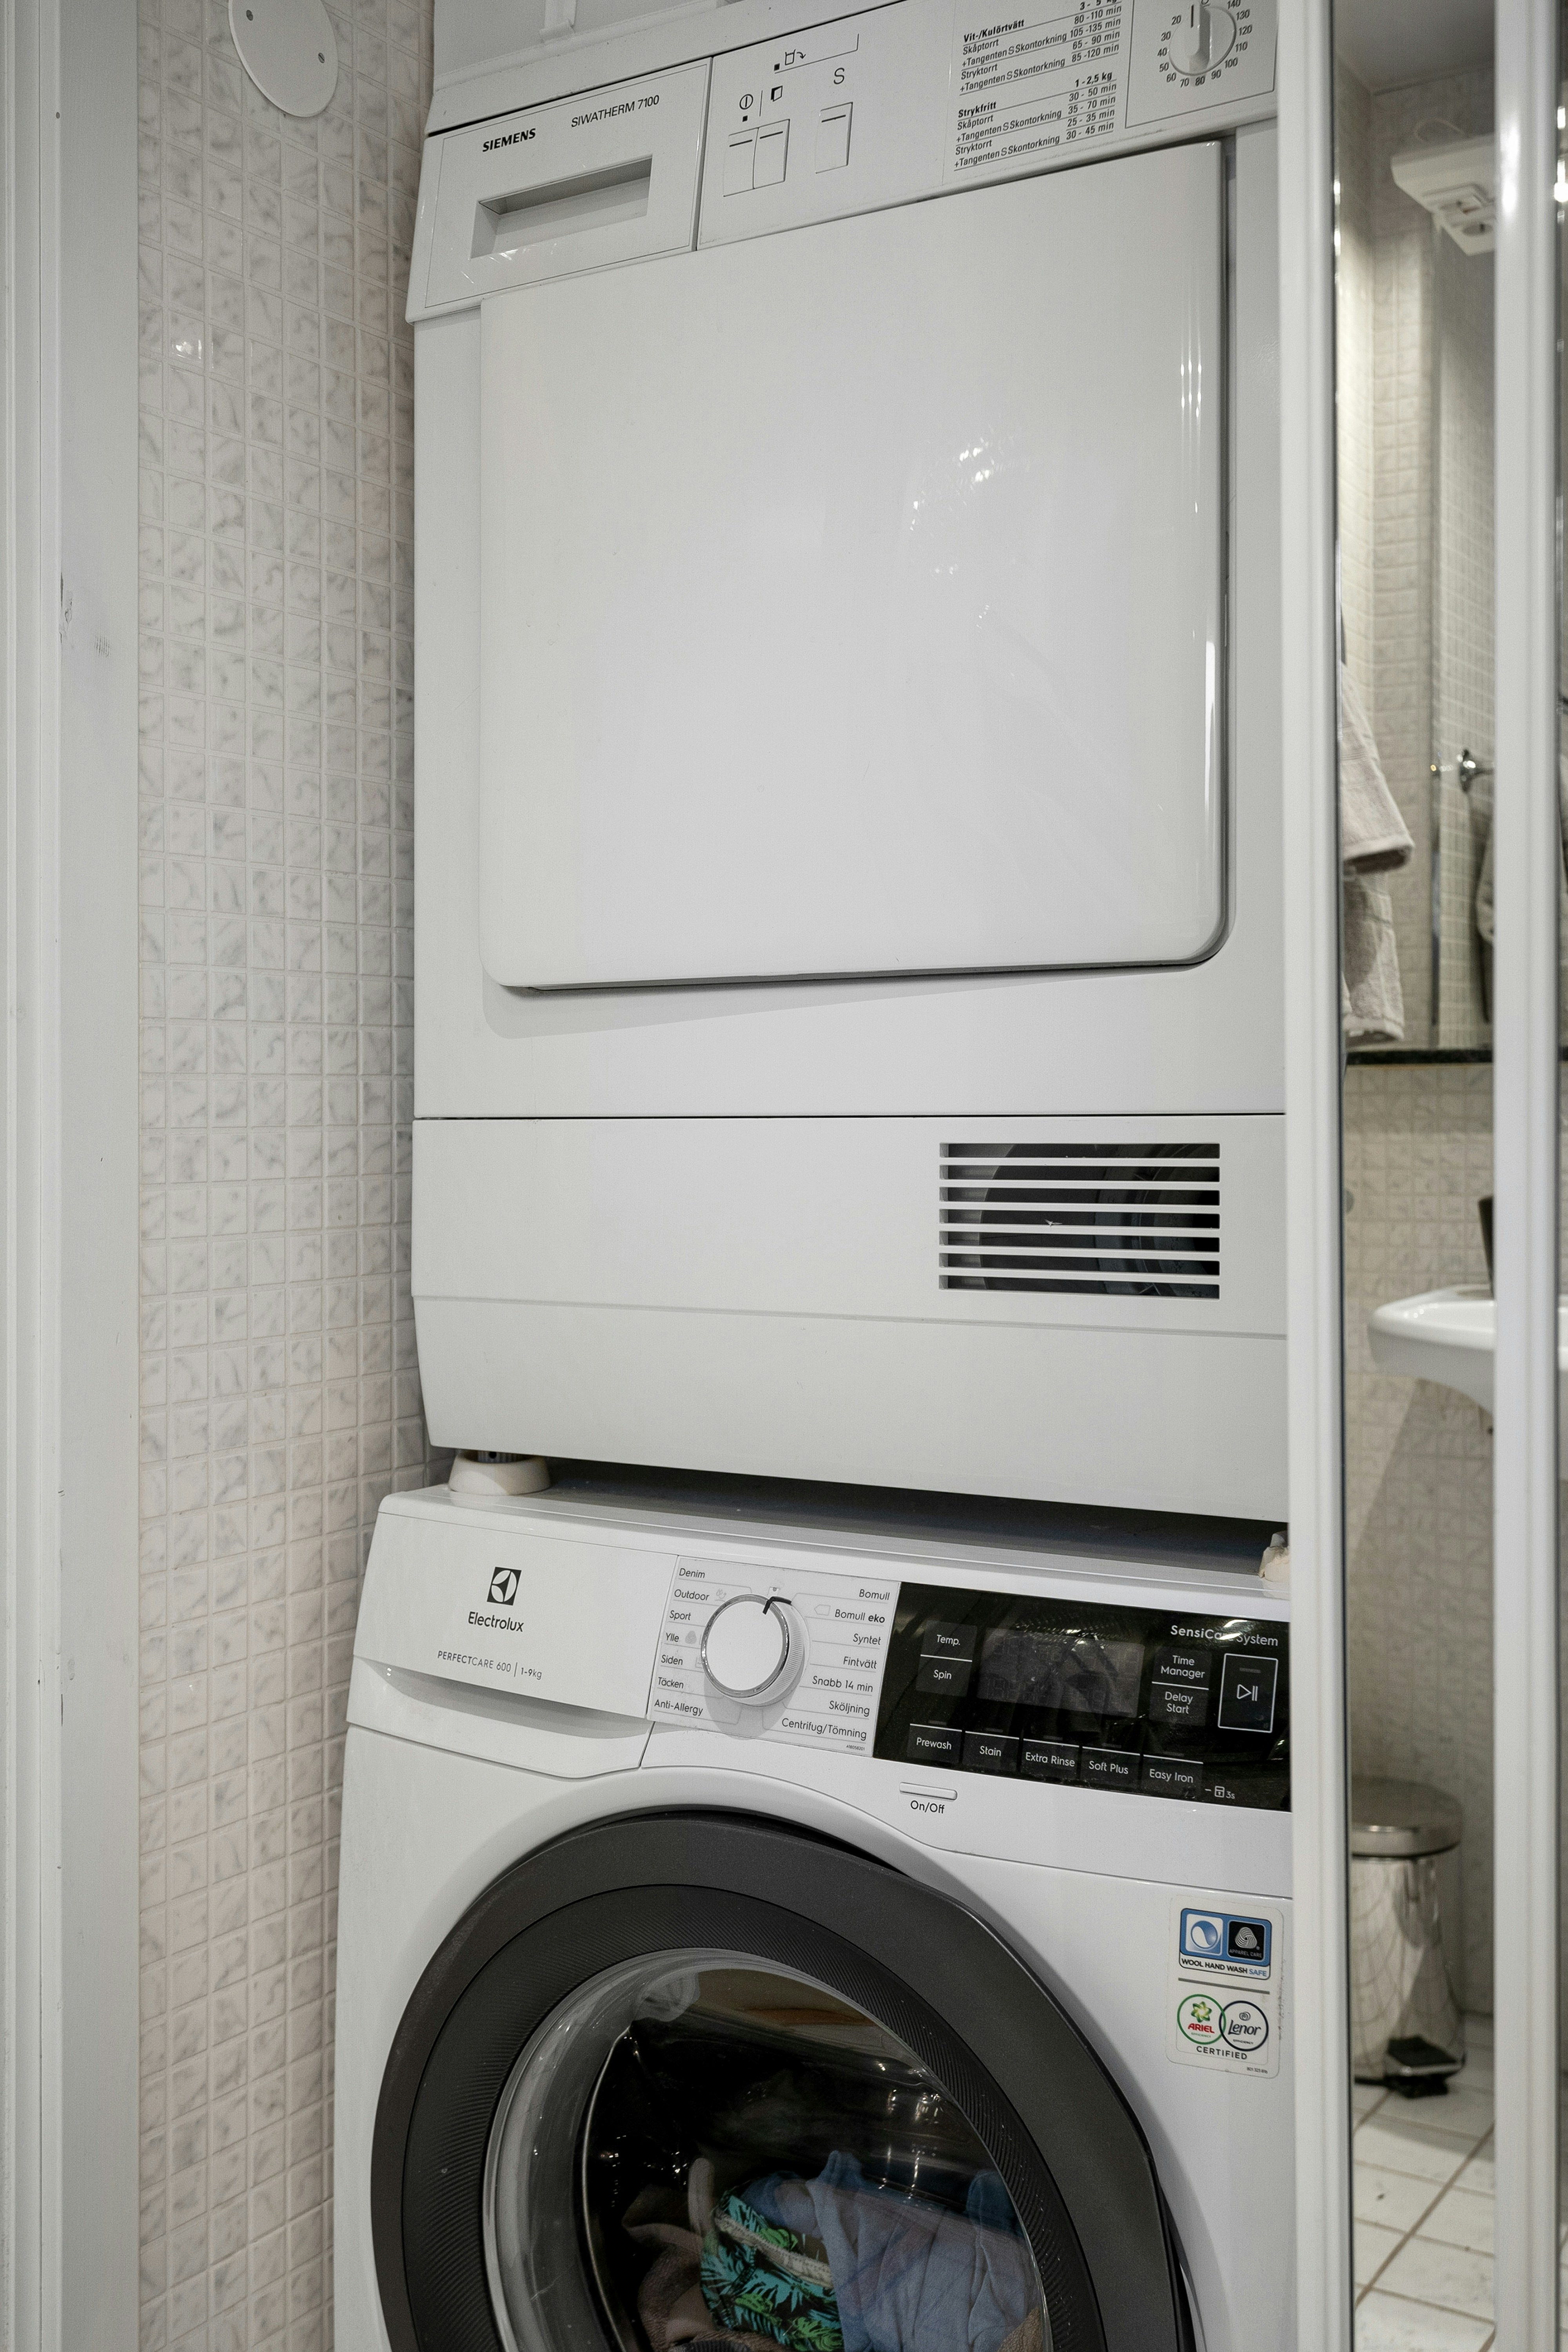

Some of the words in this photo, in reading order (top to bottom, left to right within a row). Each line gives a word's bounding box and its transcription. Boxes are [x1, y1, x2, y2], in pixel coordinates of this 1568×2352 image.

[1228, 0, 1241, 9] 140
[1074, 15, 1084, 24] 80
[1106, 5, 1121, 16] min
[1171, 15, 1181, 25] 20
[1236, 9, 1250, 20] 130
[964, 20, 1024, 43] Vit-/Kulörtvätt
[1161, 31, 1171, 41] 30
[1239, 25, 1252, 36] 120
[962, 51, 1007, 67] +Tangenten
[1015, 33, 1067, 53] Skontorkning
[1071, 27, 1083, 38] 105
[1105, 18, 1120, 29] min
[963, 39, 999, 55] Skåptorrt
[1073, 41, 1082, 50] 65
[1092, 35, 1101, 45] 90
[1104, 31, 1120, 41] min
[1236, 41, 1248, 53] 110
[1157, 47, 1167, 57] 40
[960, 75, 1005, 93] +Tangenten
[1014, 57, 1065, 78] Skontorkning
[1072, 53, 1082, 62] 85
[1103, 44, 1119, 54] min
[1159, 63, 1169, 73] 50
[1225, 58, 1238, 69] 100
[833, 68, 845, 84] S
[961, 64, 998, 80] Stryktorrt
[1086, 74, 1099, 85] 2,5
[1101, 72, 1112, 82] kg
[1167, 73, 1176, 82] 60
[1211, 69, 1221, 80] 90
[1180, 78, 1189, 88] 70
[1195, 76, 1205, 86] 80
[571, 101, 635, 127] SIWATHERM
[637, 95, 659, 110] 7100
[958, 115, 994, 131] Skåptorrt
[1069, 93, 1079, 102] 30
[1101, 83, 1116, 93] min
[958, 102, 996, 118] Strykfritt
[956, 125, 1002, 142] +Tangenten
[1010, 109, 1062, 129] Skontorkning
[1068, 106, 1078, 114] 35
[1100, 96, 1115, 106] min
[956, 140, 992, 156] Stryktorrt
[1067, 119, 1077, 127] 25
[1099, 109, 1114, 119] min
[483, 129, 536, 152] SIEMENS
[954, 151, 1000, 168] +Tangenten
[1008, 135, 1060, 154] Skontorkning
[1066, 132, 1076, 141] 30
[1098, 122, 1114, 132] min
[679, 1568, 705, 1578] Denim
[674, 1589, 710, 1601] Outdoor
[859, 1589, 890, 1600] Bomull
[468, 1612, 524, 1632] Electrolux
[669, 1610, 691, 1621] Sport
[835, 1610, 865, 1621] Bomull
[868, 1614, 885, 1623] eko
[666, 1633, 679, 1642] Ylle
[853, 1633, 881, 1645] Syntet
[936, 1635, 960, 1646] Temp.
[1171, 1625, 1233, 1642] SensiCa
[1237, 1632, 1278, 1646] System
[437, 1651, 494, 1669] PERFECTCARE
[497, 1662, 511, 1672] 600
[521, 1668, 542, 1680] 1-9kg
[661, 1655, 683, 1665] Siden
[843, 1657, 877, 1669] Fintvätt
[1173, 1655, 1194, 1666] Time
[933, 1670, 952, 1681] Spin
[1161, 1666, 1205, 1679] Manager
[658, 1677, 684, 1689] Täcken
[812, 1676, 842, 1688] Snabb
[846, 1680, 853, 1690] 14
[857, 1684, 873, 1692] min
[1165, 1691, 1193, 1704] Delay
[654, 1699, 703, 1717] Anti-Allergy
[829, 1701, 870, 1717] Sköljning
[1167, 1704, 1189, 1714] Start
[782, 1718, 867, 1740] Centrifug/Tömning
[916, 1738, 952, 1750] Prewash
[980, 1746, 1002, 1757] Stain
[1025, 1752, 1048, 1763] Extra
[1051, 1757, 1075, 1767] Rinse
[1089, 1761, 1107, 1771] Soft
[1111, 1765, 1128, 1775] Plus
[1150, 1769, 1172, 1782] Easy
[1175, 1773, 1193, 1783] Iron
[1226, 1791, 1235, 1799] 3s
[910, 1800, 945, 1814] On/Off
[1181, 1958, 1203, 1967] WOOL
[1205, 1962, 1225, 1971] HAND
[1227, 1965, 1247, 1974] WASH
[1188, 2023, 1215, 2033] ARIEL
[1228, 2020, 1261, 2035] Lenor
[1196, 2046, 1247, 2059] CERTIFIED
